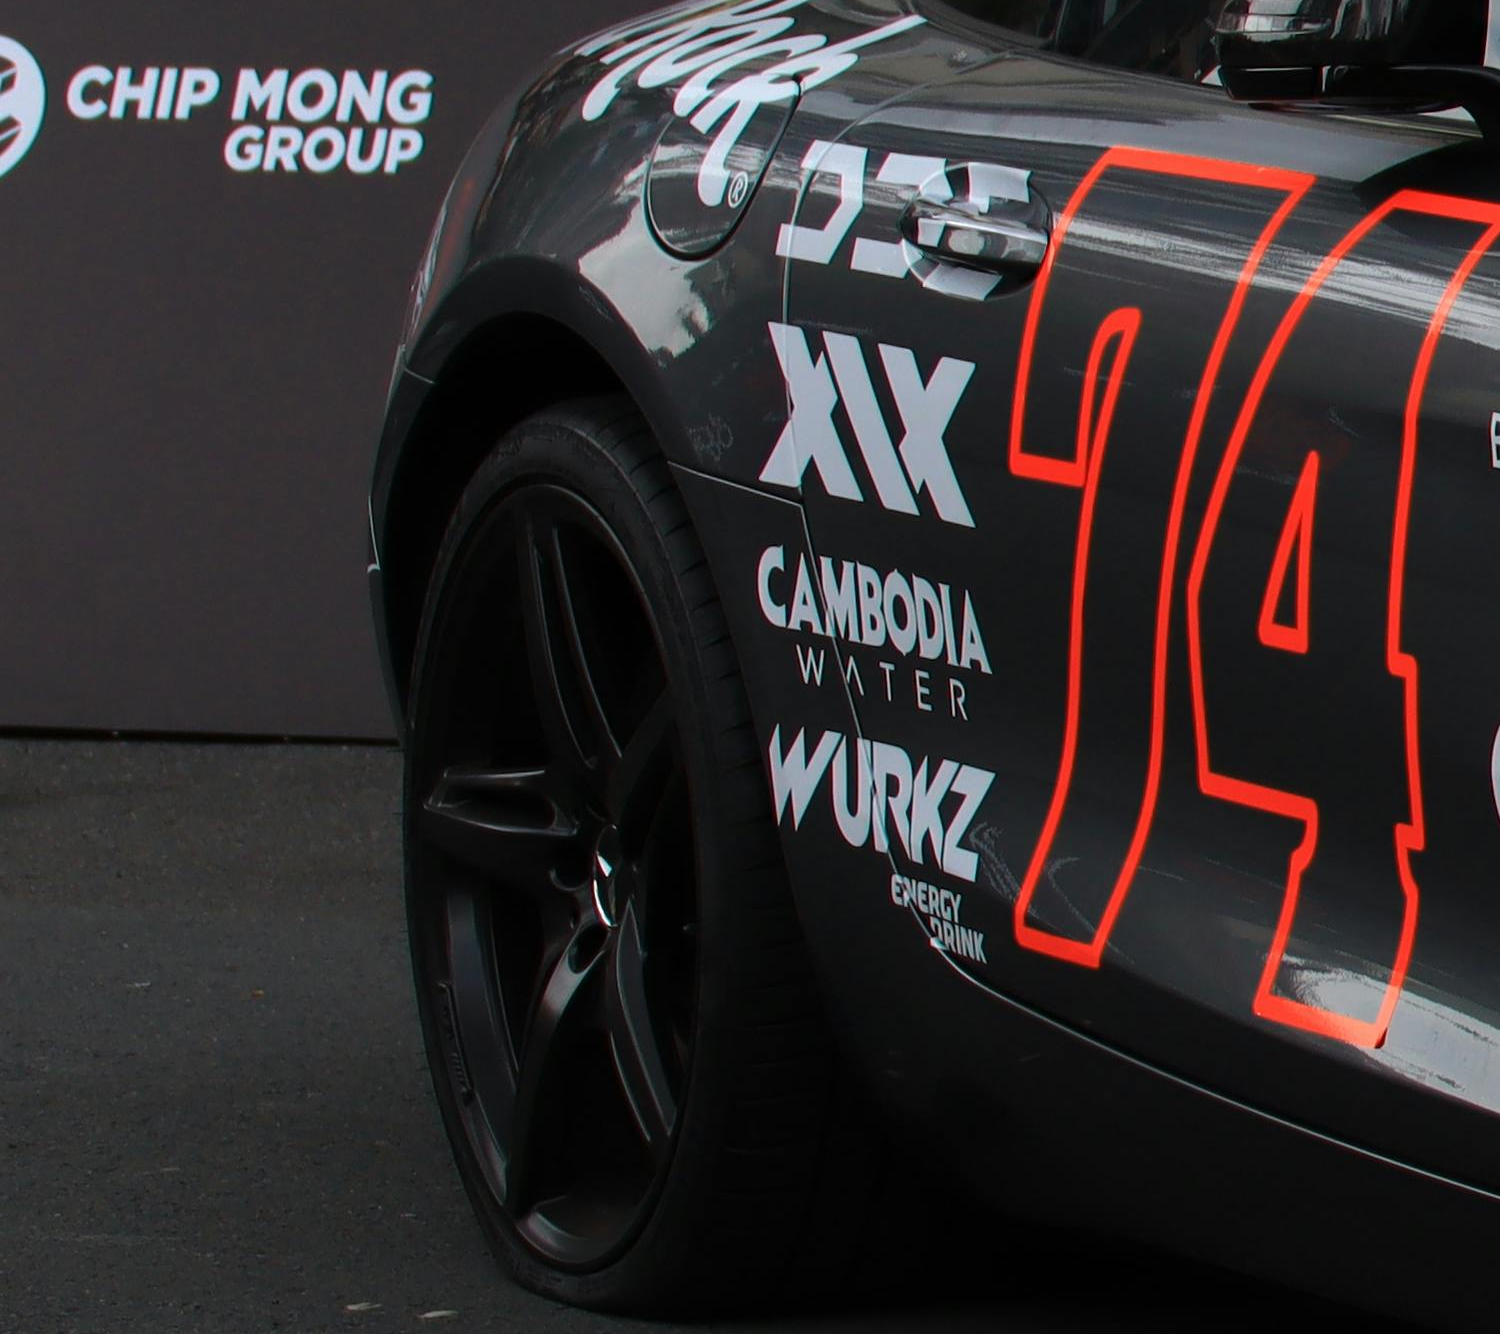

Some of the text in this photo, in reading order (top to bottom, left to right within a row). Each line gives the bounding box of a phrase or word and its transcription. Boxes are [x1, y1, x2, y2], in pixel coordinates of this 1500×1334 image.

[66, 65, 434, 124] CHIP MONG
[224, 125, 424, 174] GROUP
[757, 544, 992, 674] CAMBODIA
[767, 723, 996, 882] WURKZ
[891, 873, 962, 923] ENERGY
[930, 915, 987, 965] DRINK
